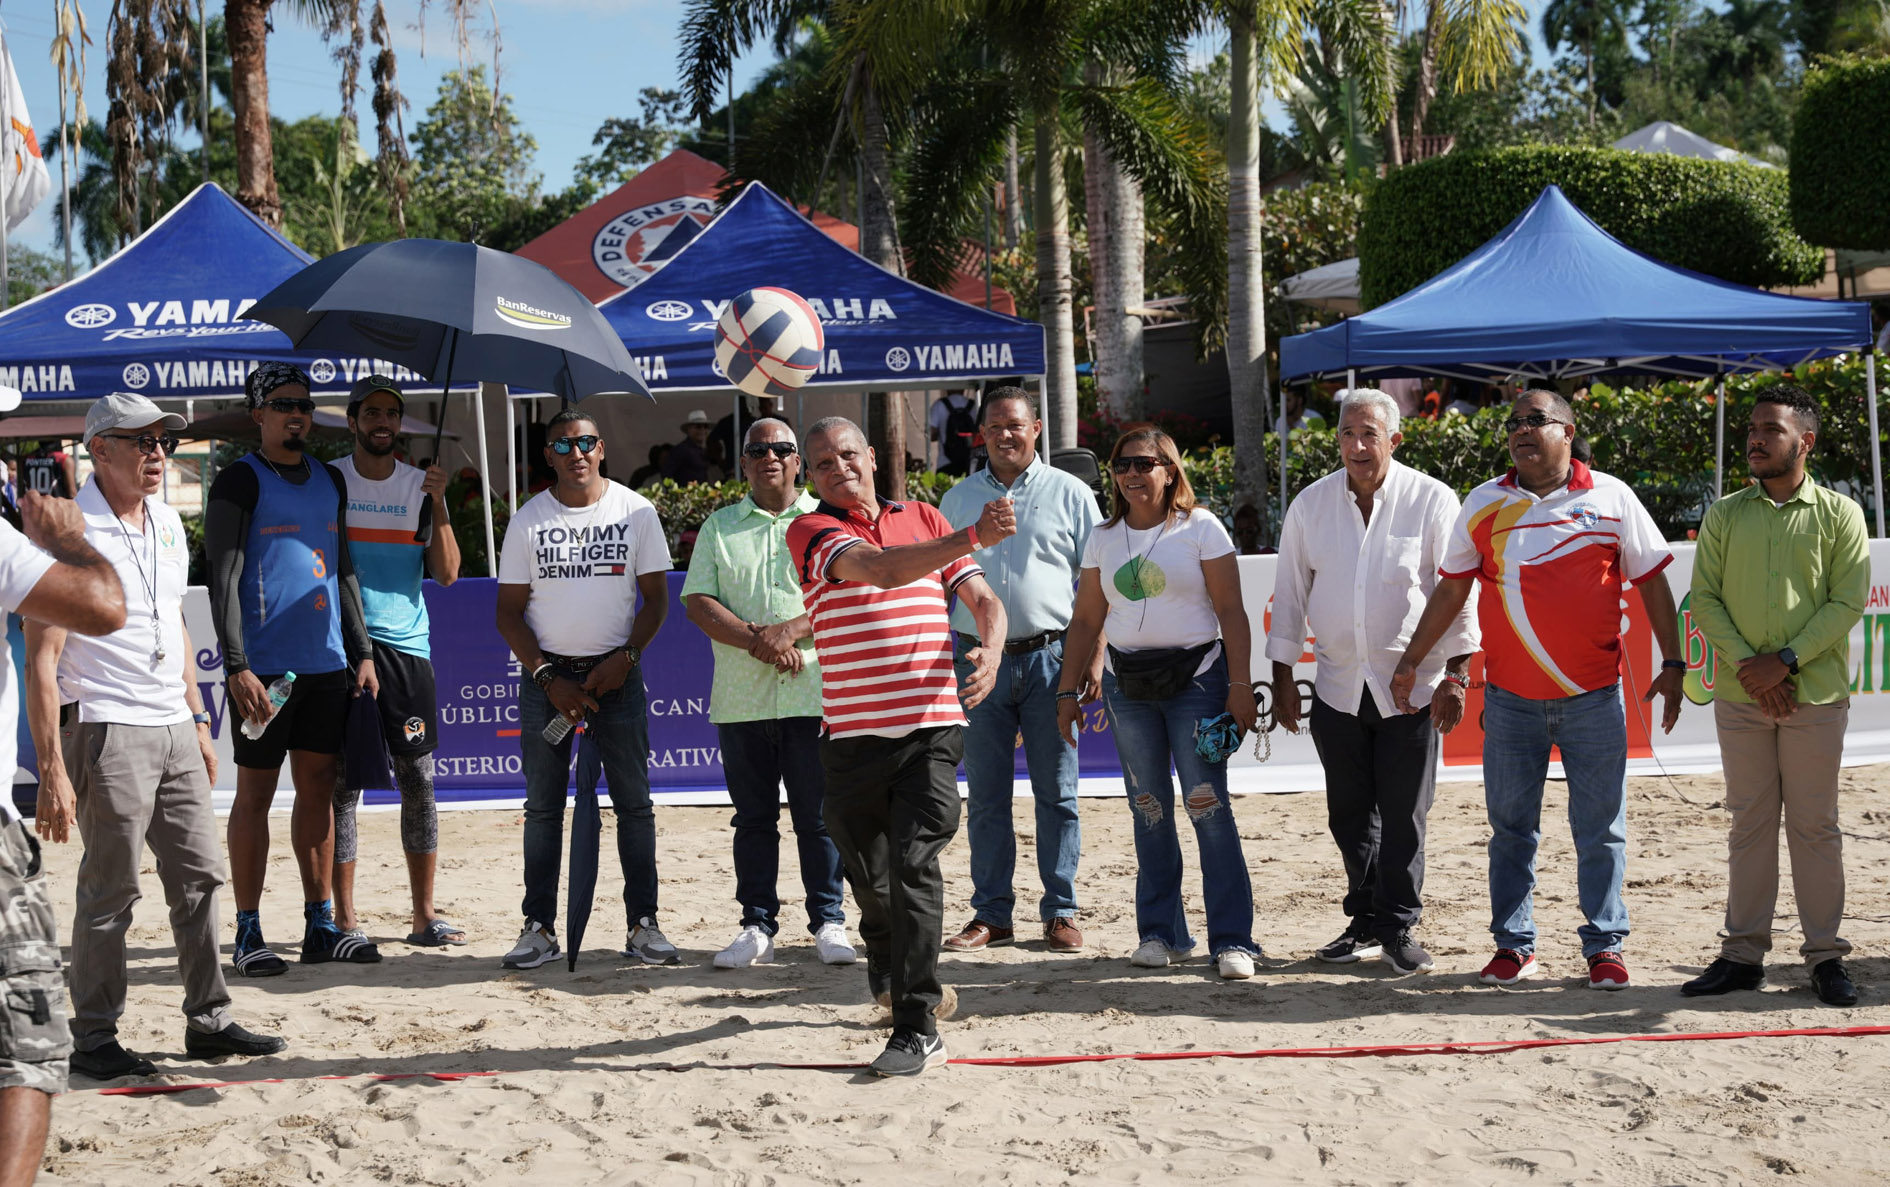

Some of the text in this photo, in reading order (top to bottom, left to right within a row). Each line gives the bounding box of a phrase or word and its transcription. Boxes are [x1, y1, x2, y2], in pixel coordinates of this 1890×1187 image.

[601, 200, 712, 262] DEFENSA
[496, 296, 572, 324] BanReservas
[701, 297, 897, 321] YAHA
[102, 327, 188, 341] Revs
[187, 323, 248, 337] Your
[914, 343, 1015, 371] YAMAHA
[29, 466, 51, 494] 10
[536, 523, 630, 546] TOMMY
[312, 549, 327, 579] 3
[536, 543, 629, 565] HILFIGER
[538, 563, 592, 579] DENIM
[1865, 585, 1890, 608] AN
[440, 703, 519, 725] ÚBLIC
